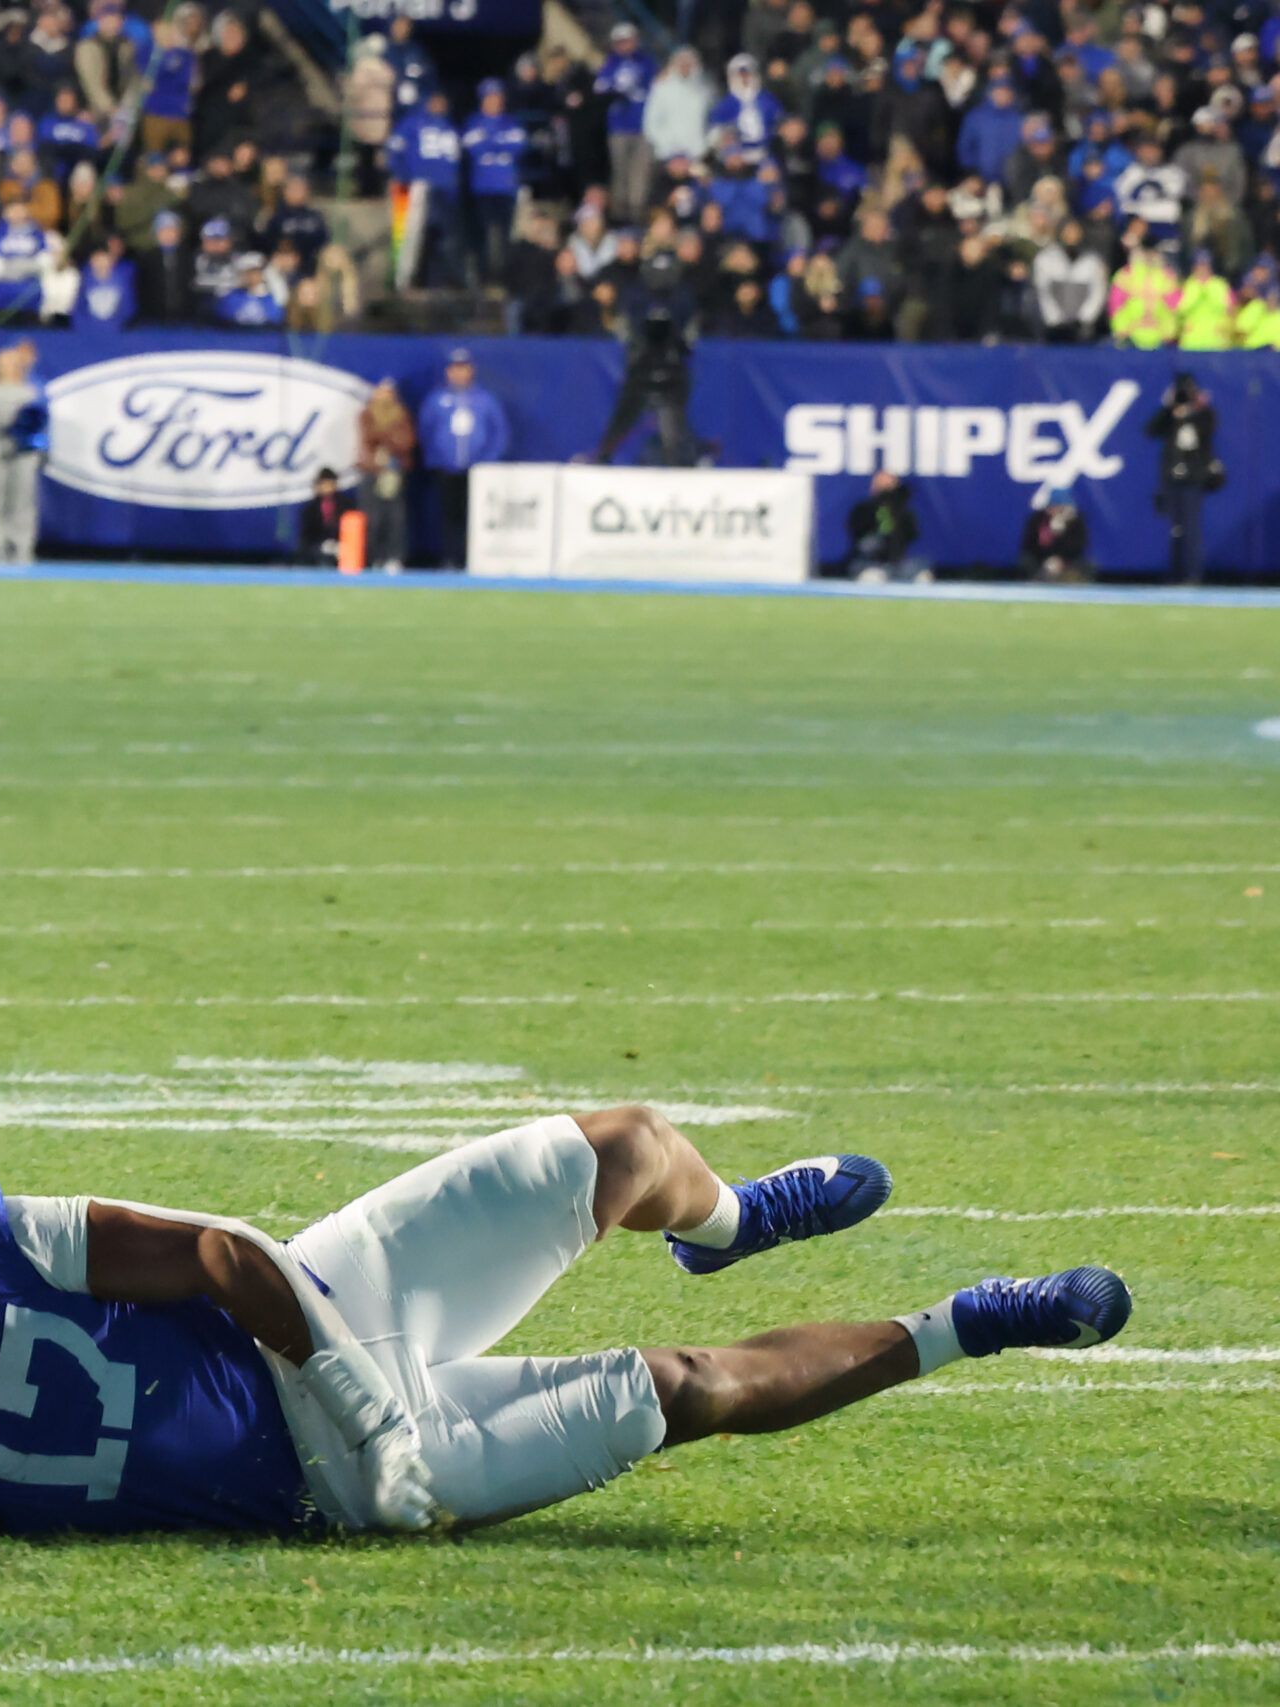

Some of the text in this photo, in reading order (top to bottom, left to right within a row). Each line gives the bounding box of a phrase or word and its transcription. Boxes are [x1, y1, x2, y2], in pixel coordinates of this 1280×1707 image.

[96, 380, 320, 472] Ford
[783, 378, 1141, 509] SHIPEX
[639, 496, 773, 540] vivint
